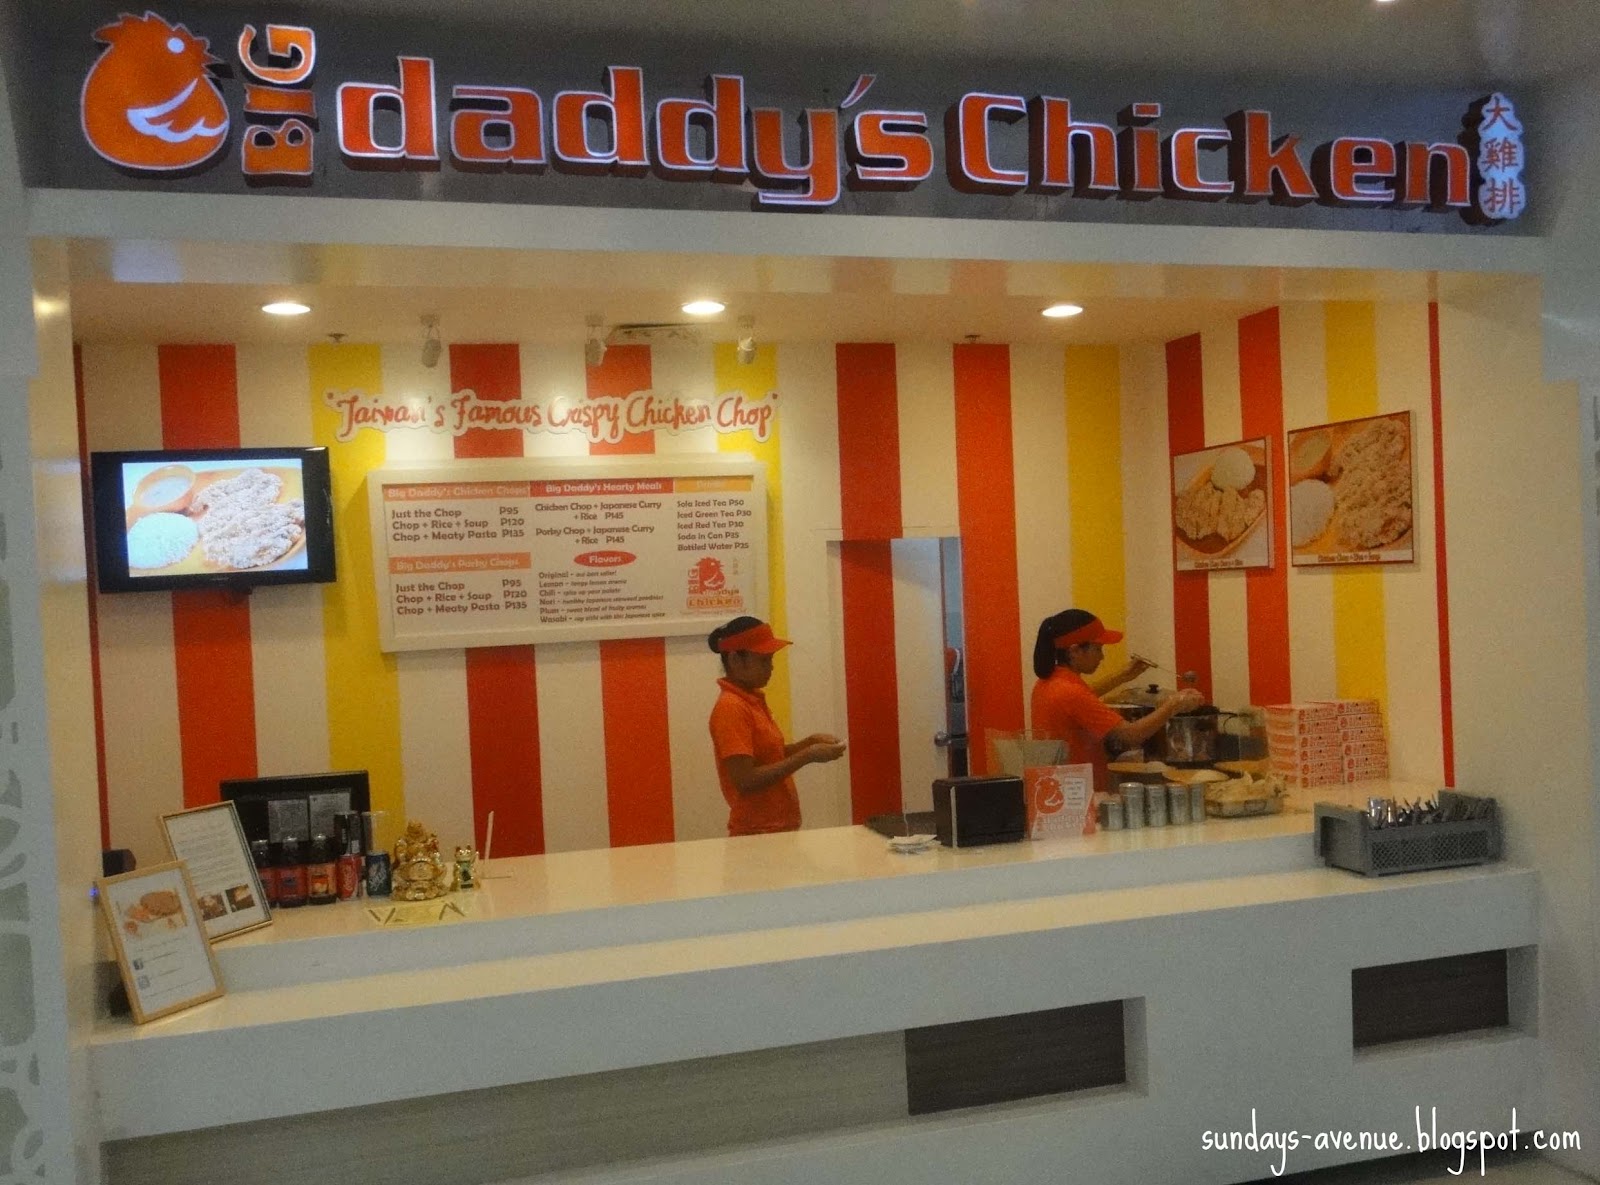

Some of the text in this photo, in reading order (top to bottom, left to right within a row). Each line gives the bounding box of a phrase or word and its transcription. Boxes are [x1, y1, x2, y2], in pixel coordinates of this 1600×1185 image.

[238, 23, 317, 176] BIG
[337, 55, 1471, 207] daddy's Chicken
[453, 394, 542, 431] Famous
[626, 396, 712, 430] Chicken
[546, 482, 662, 494] Big Daddy's Hearty Meals
[535, 503, 569, 511] Chicken
[570, 502, 592, 511] Chop
[600, 502, 637, 511] Japanese
[638, 501, 662, 510] Curry
[713, 499, 727, 507] Tea
[391, 506, 519, 519] Just the Chop P95
[580, 512, 598, 520] Rice
[695, 510, 718, 518] Green
[392, 521, 420, 531] Chop
[431, 520, 453, 529] Rice
[464, 519, 489, 529] Soup
[500, 518, 525, 526] P120
[563, 527, 585, 536] Chop
[593, 526, 630, 535] Japanese
[632, 525, 655, 534] Curry
[392, 532, 420, 542] Chop
[432, 531, 465, 541] Meaty
[468, 530, 497, 539] Pasta
[502, 529, 525, 537] P135
[581, 536, 598, 544] Rice
[606, 536, 625, 544] P145
[589, 555, 622, 564] Flavors
[538, 571, 569, 579] Original
[395, 579, 522, 593] Just the Chop P95
[396, 595, 424, 604] Chop
[435, 593, 457, 602] Rice
[467, 592, 492, 601] Soup
[503, 590, 527, 598] P120
[397, 606, 424, 615] Chop
[435, 604, 468, 614] Meaty
[471, 603, 500, 612] Pasta
[505, 601, 527, 610] P135
[540, 615, 567, 623] Wasabi
